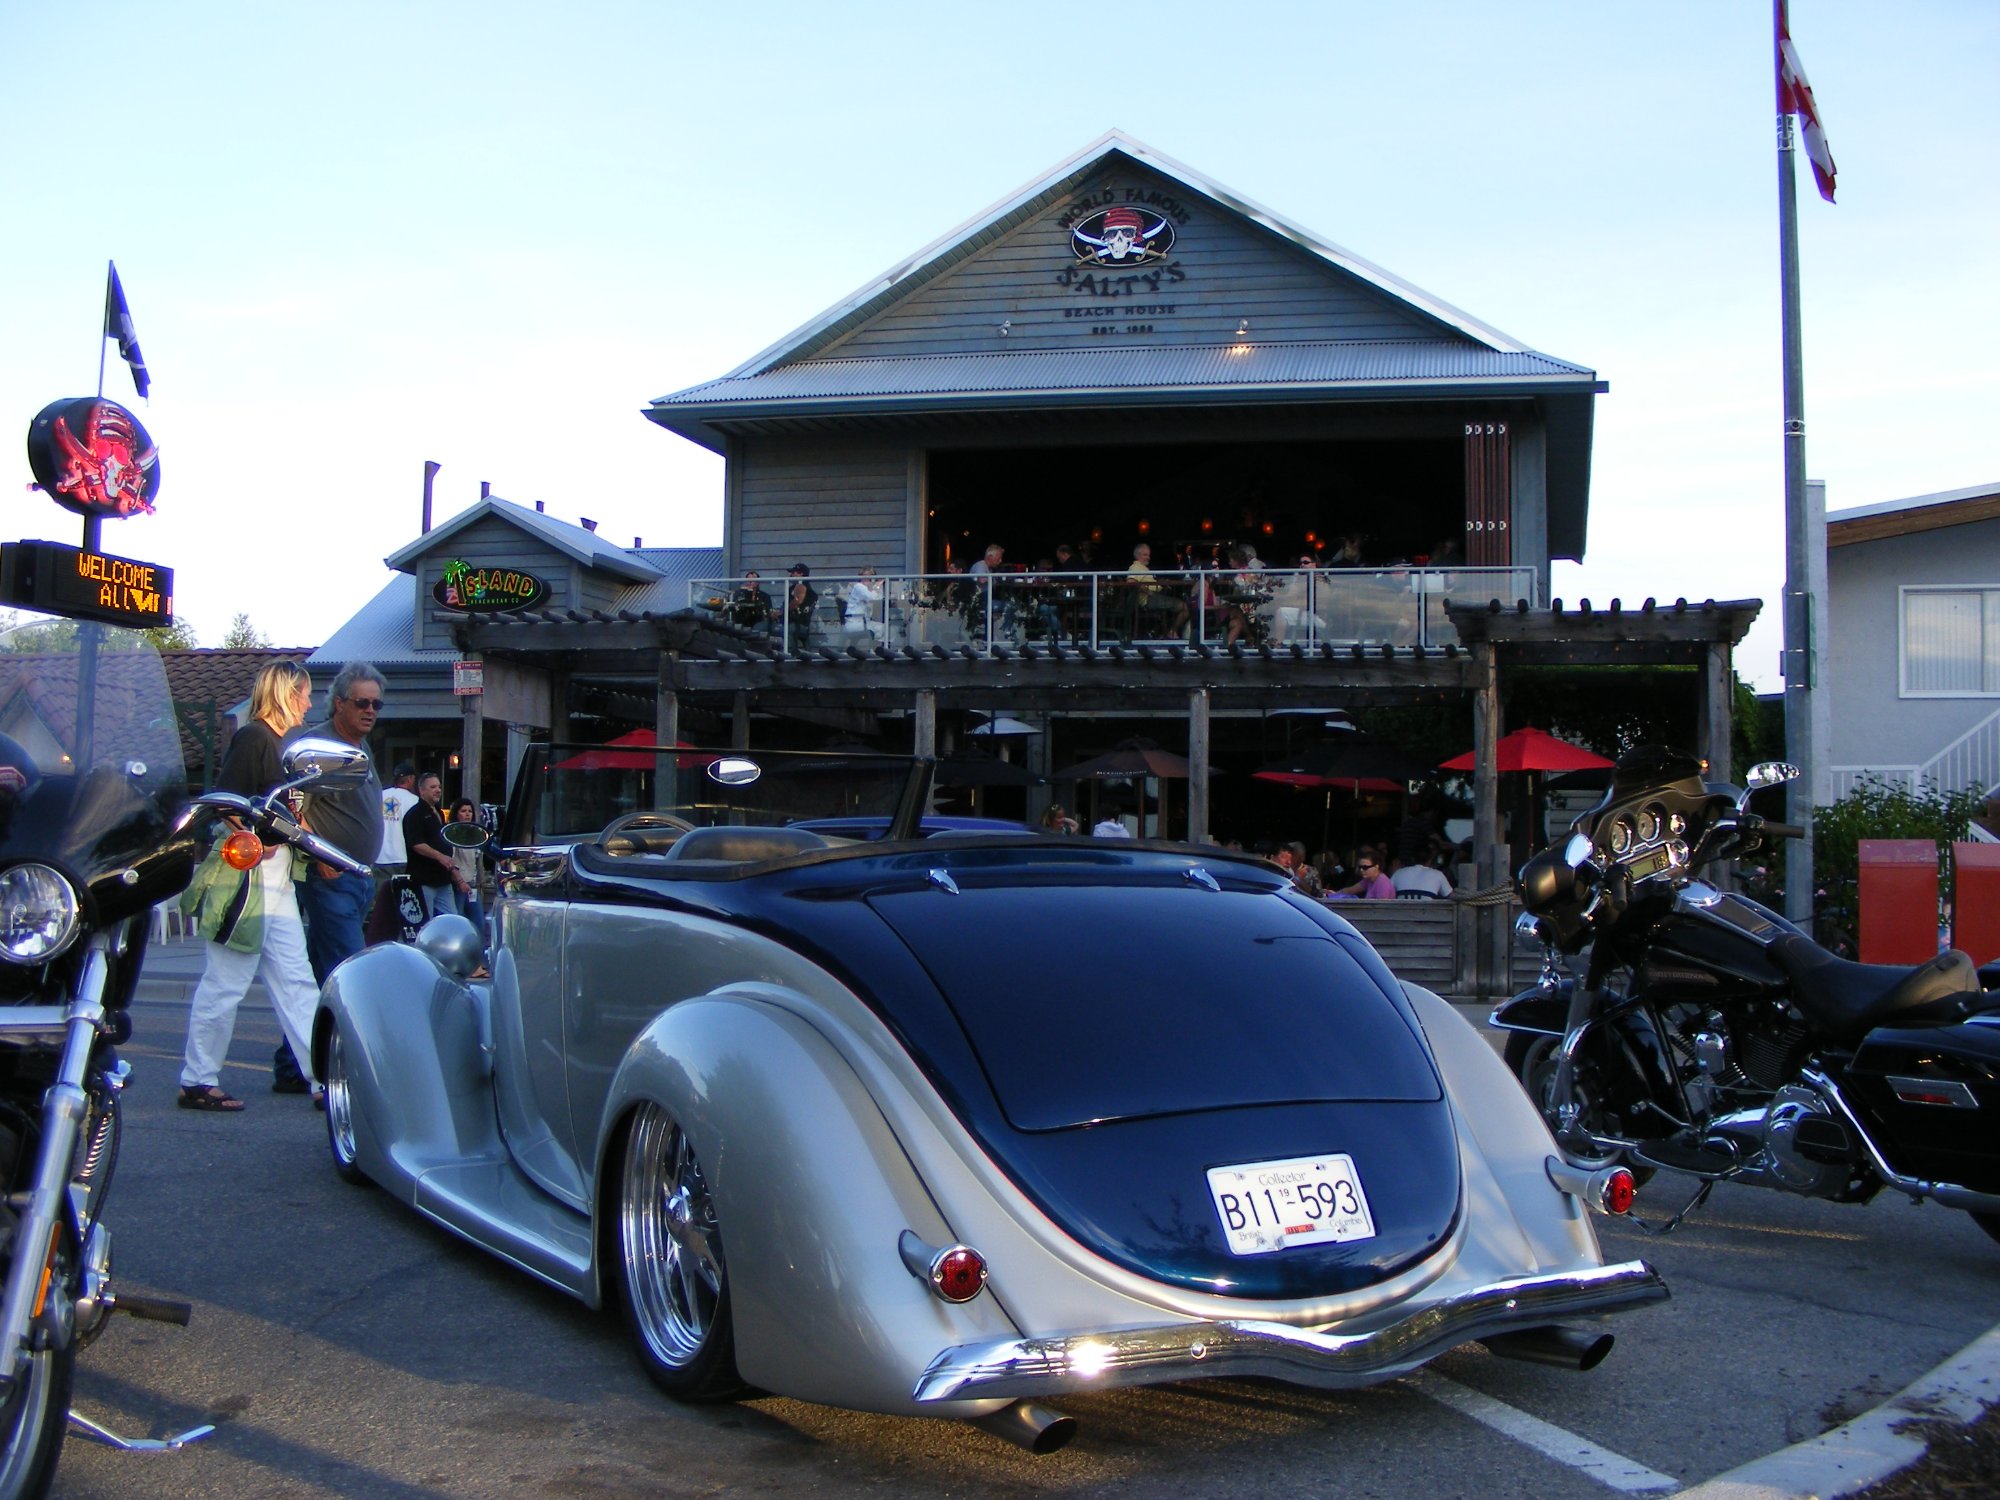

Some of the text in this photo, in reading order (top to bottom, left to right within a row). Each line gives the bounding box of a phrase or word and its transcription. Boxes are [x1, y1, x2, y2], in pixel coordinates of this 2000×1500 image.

[1058, 188, 1191, 229] WORLD FAMOUS
[1056, 261, 1186, 297] SALTY'S
[1064, 305, 1177, 318] BEACH HOUSE
[79, 552, 155, 591] WELCOME
[453, 568, 534, 606] ISLAND
[1258, 1170, 1307, 1186] Collector
